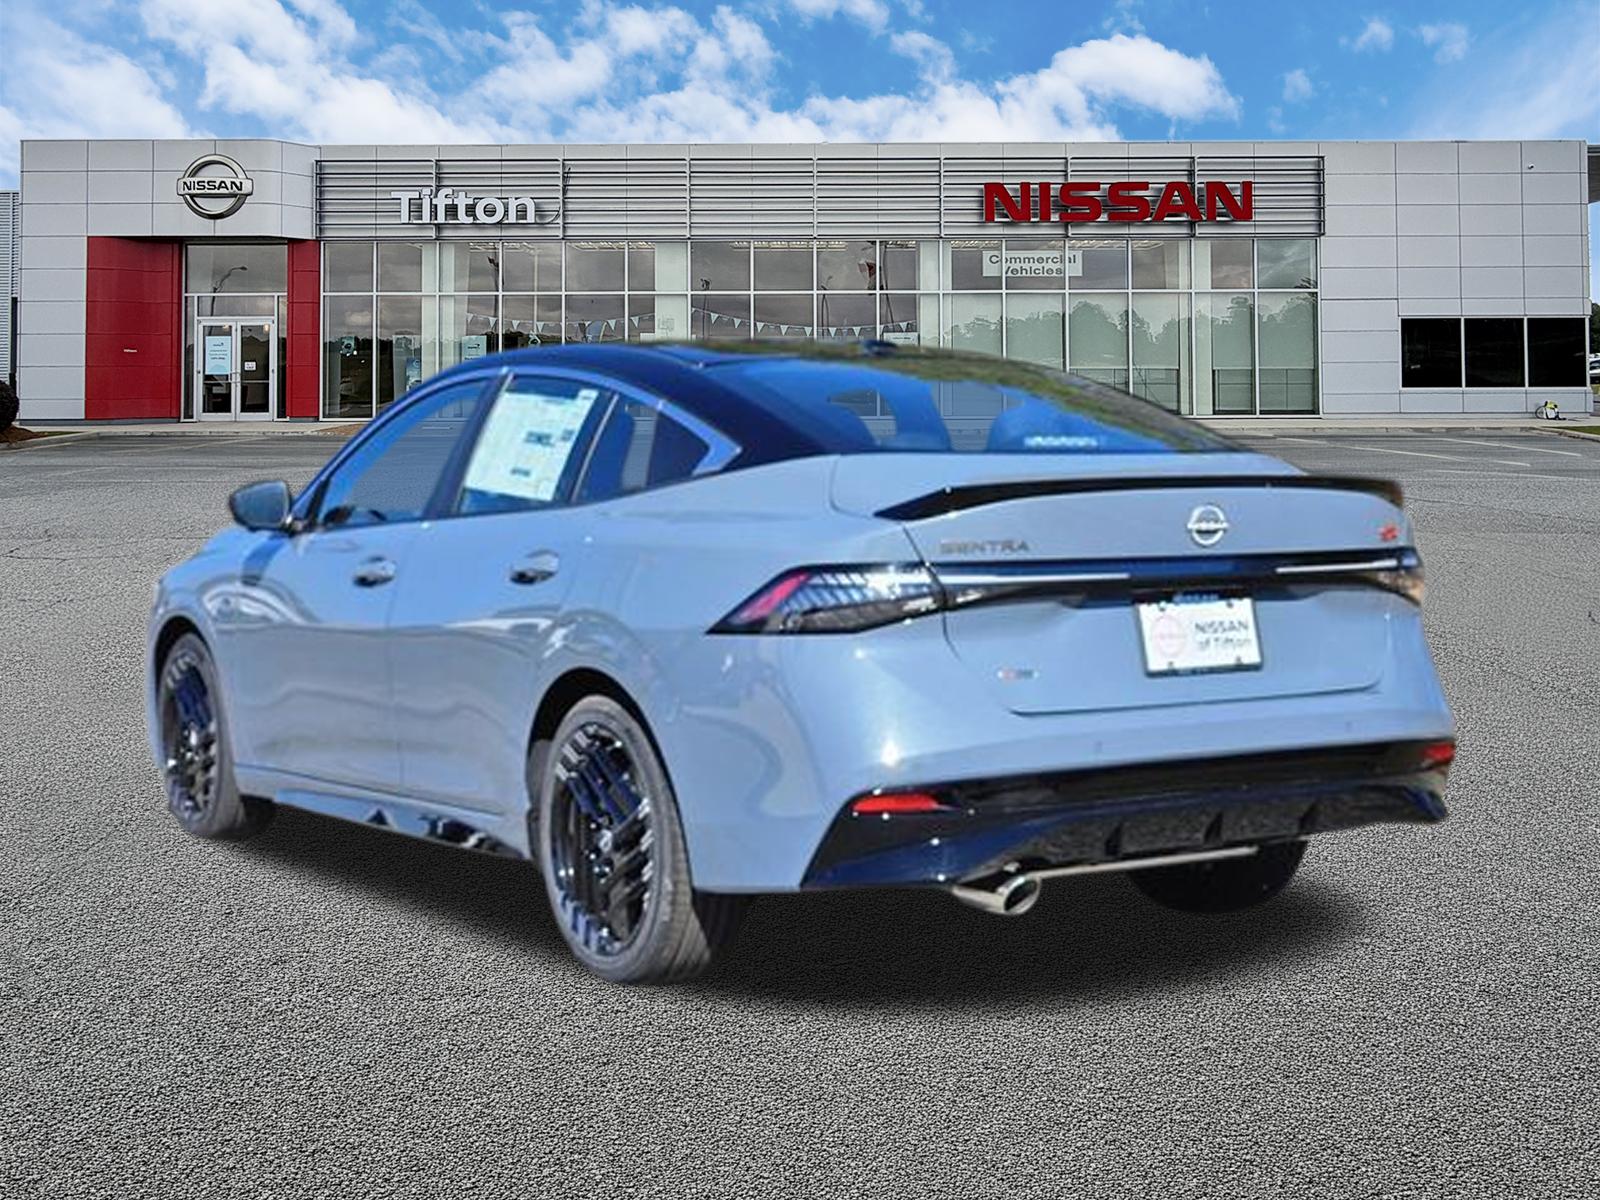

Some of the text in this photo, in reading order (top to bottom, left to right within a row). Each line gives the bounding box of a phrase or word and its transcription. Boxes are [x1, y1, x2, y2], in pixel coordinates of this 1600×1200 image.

[182, 180, 243, 192] NISSAN
[390, 188, 536, 224] Tifton
[983, 180, 1254, 222] NISSAN
[1193, 619, 1250, 634] NISSAN
